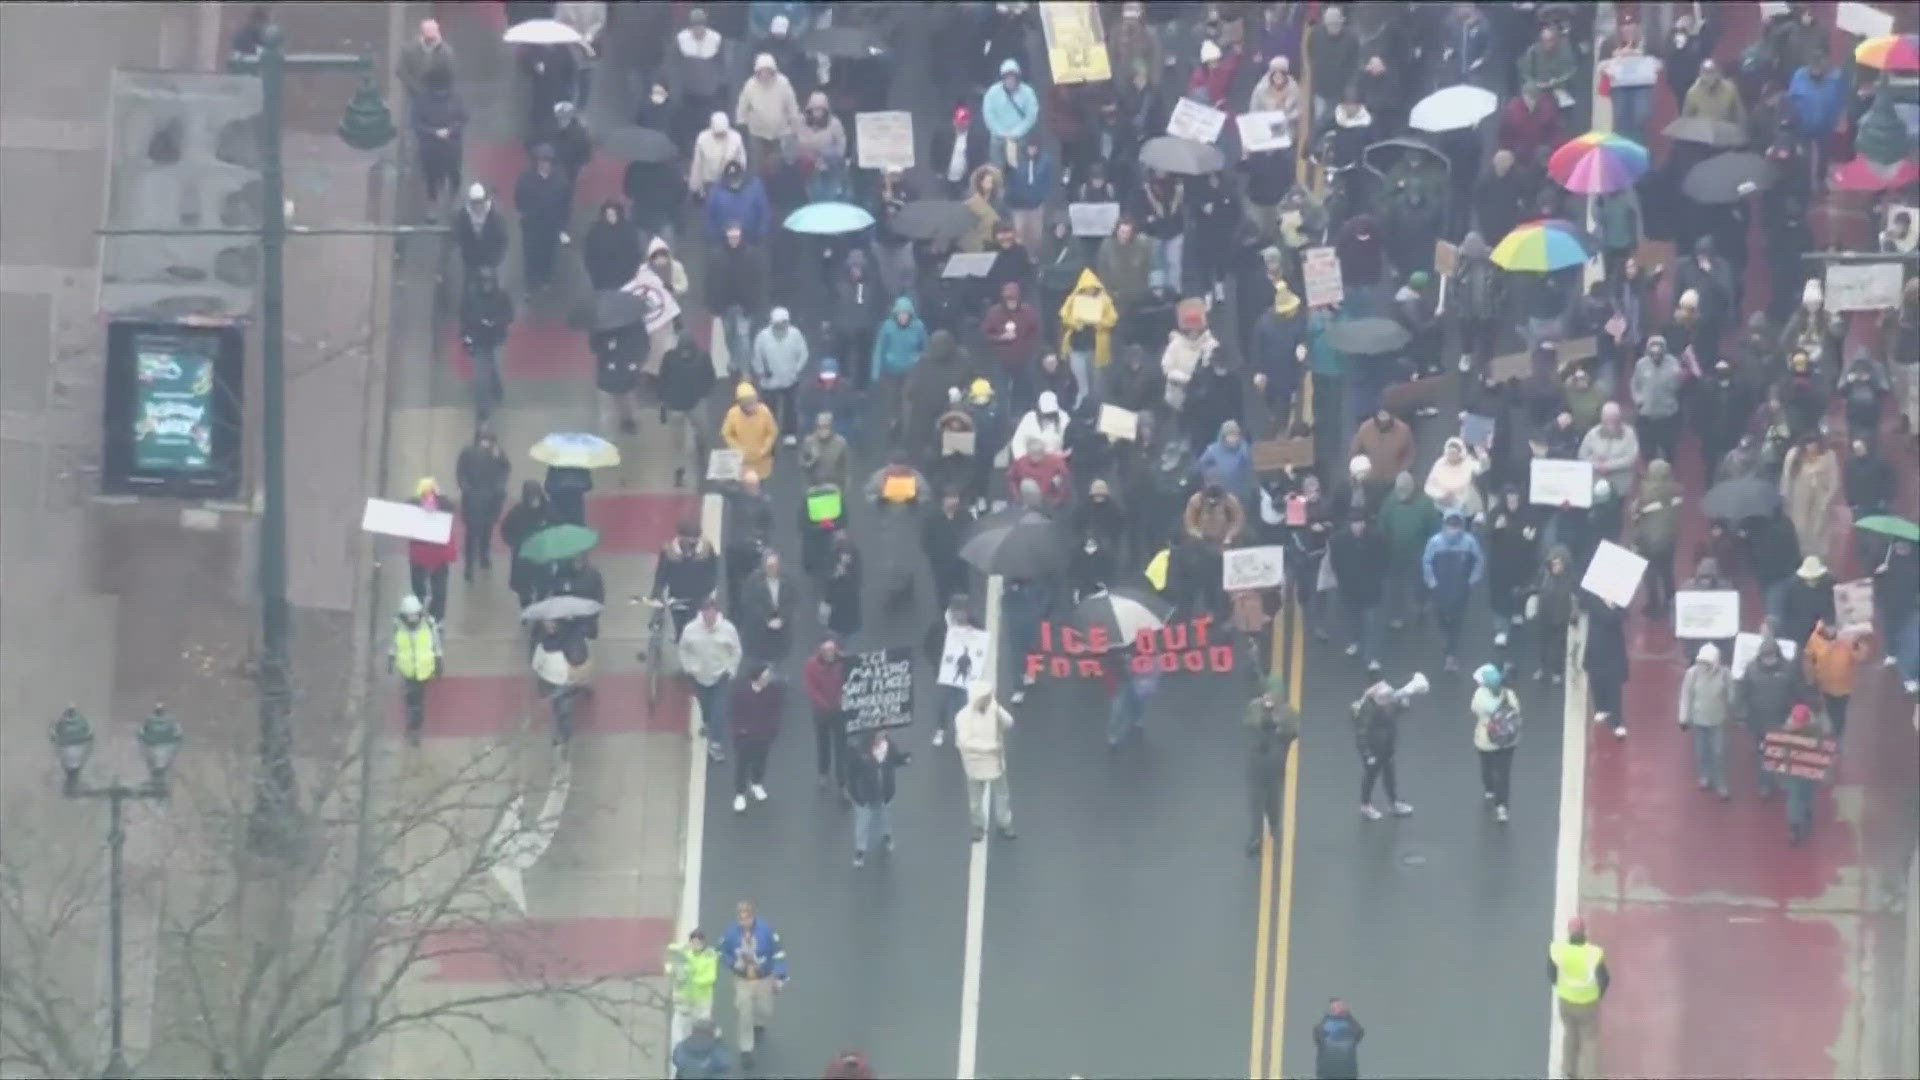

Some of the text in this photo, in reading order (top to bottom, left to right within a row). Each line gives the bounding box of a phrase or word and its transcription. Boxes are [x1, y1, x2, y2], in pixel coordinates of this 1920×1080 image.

[1040, 613, 1213, 653] ICE OUT
[1025, 646, 1233, 678] FOR GOOD
